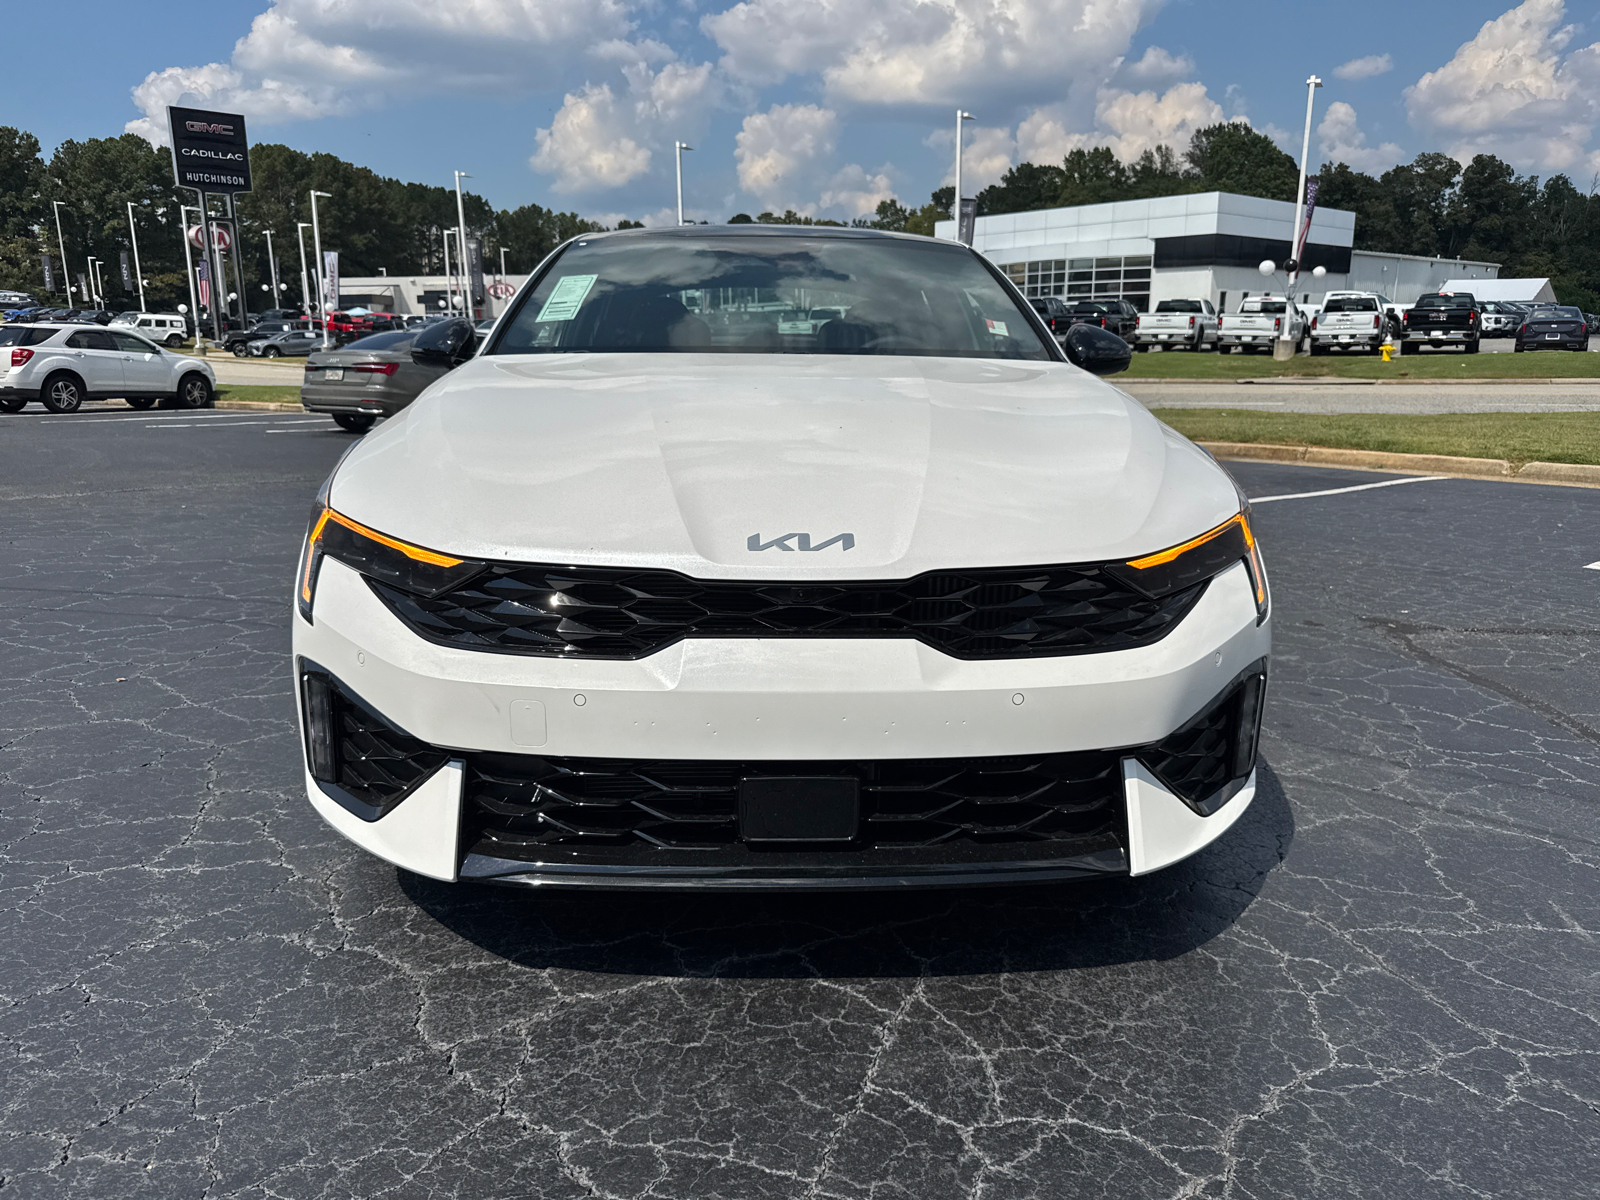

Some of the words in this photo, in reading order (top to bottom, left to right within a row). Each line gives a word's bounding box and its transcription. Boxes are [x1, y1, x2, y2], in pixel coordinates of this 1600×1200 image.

[186, 121, 234, 135] GMC
[181, 148, 243, 161] CADILLAC
[186, 172, 245, 185] HUTCHINSON
[747, 532, 855, 551] KIA
